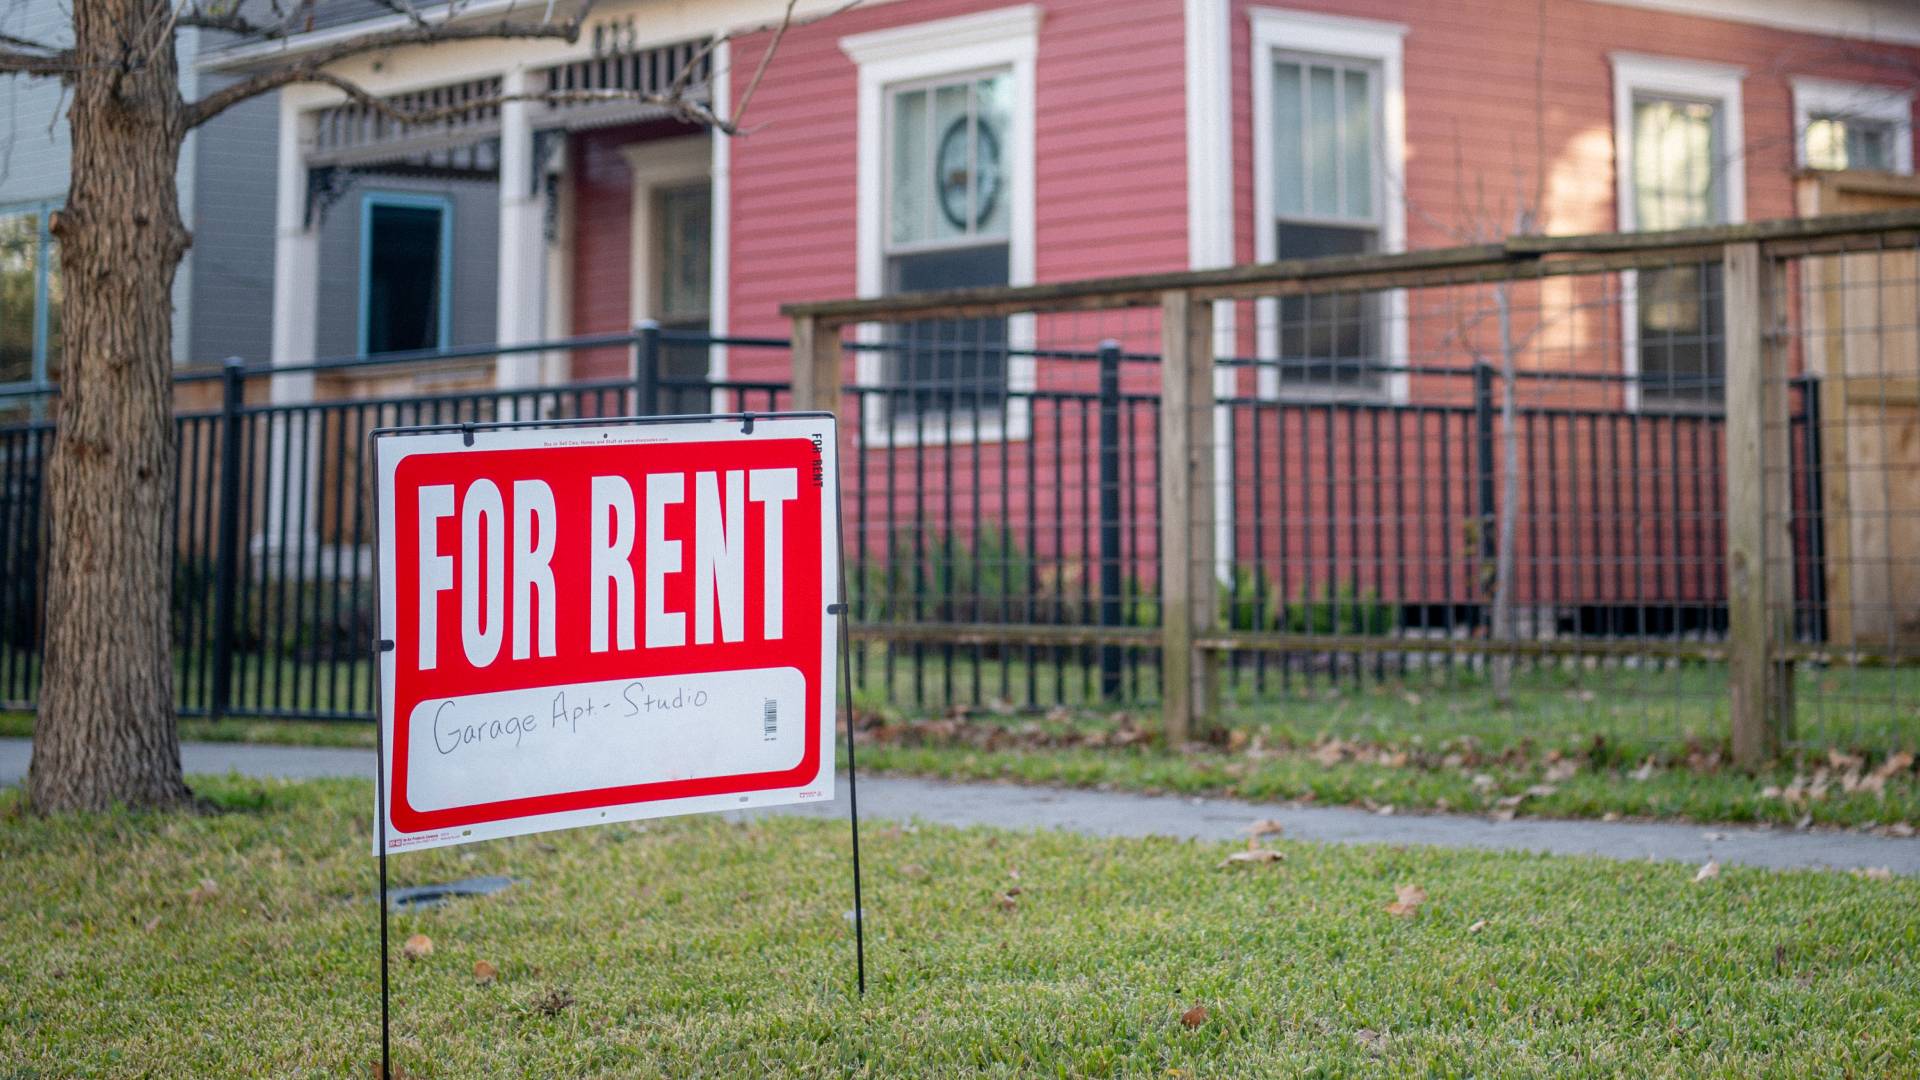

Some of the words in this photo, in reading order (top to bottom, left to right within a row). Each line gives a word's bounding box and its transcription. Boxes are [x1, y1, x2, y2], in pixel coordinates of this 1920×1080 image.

[812, 433, 822, 454] FOR
[812, 459, 823, 487] RENT
[418, 478, 557, 670] FOR
[591, 467, 798, 653] RENT
[433, 700, 537, 755] Garage
[623, 682, 708, 717] Studio
